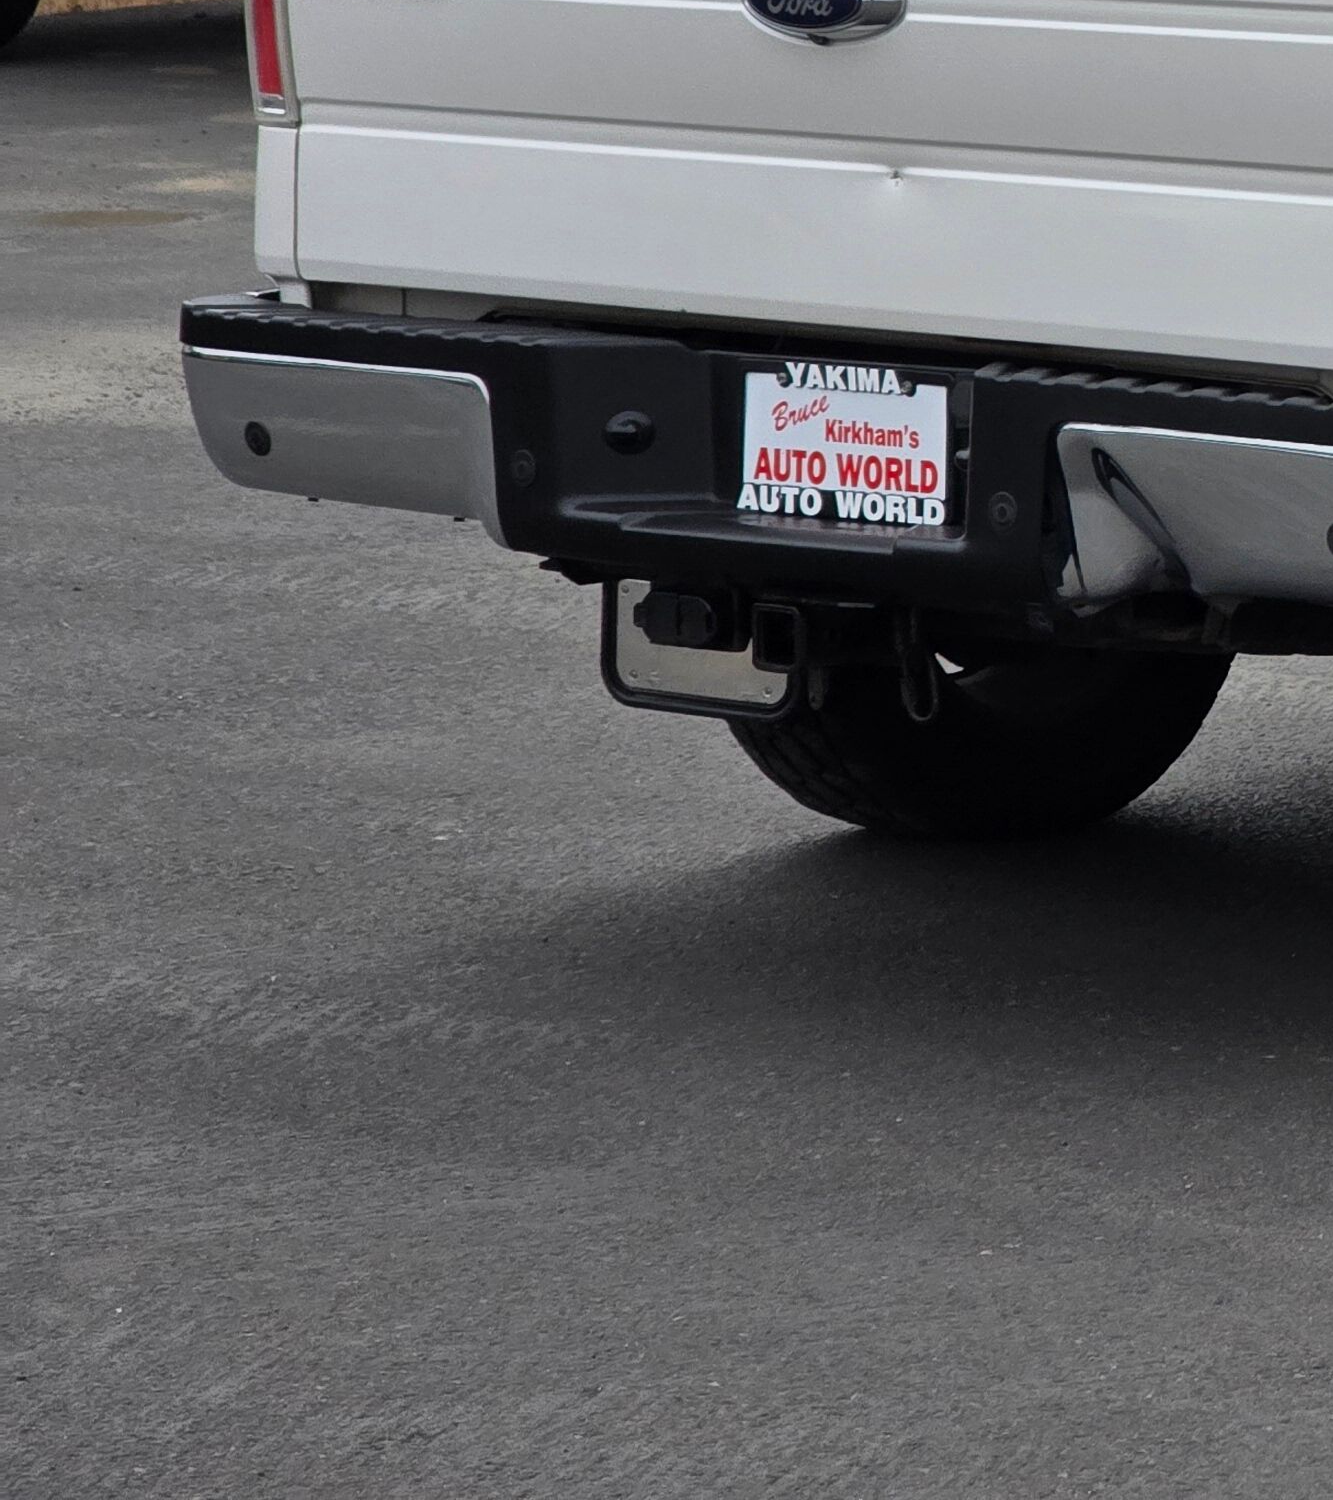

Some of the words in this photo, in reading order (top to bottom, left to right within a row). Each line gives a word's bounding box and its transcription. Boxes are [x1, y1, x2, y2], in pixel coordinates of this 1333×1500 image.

[785, 362, 901, 395] YAKIMA
[772, 396, 831, 431] Bruce
[825, 418, 920, 449] Kirkham's
[754, 447, 827, 485] AUTO
[836, 453, 939, 494] WORLD
[736, 482, 823, 517] AUTO
[835, 490, 946, 526] WORLD
